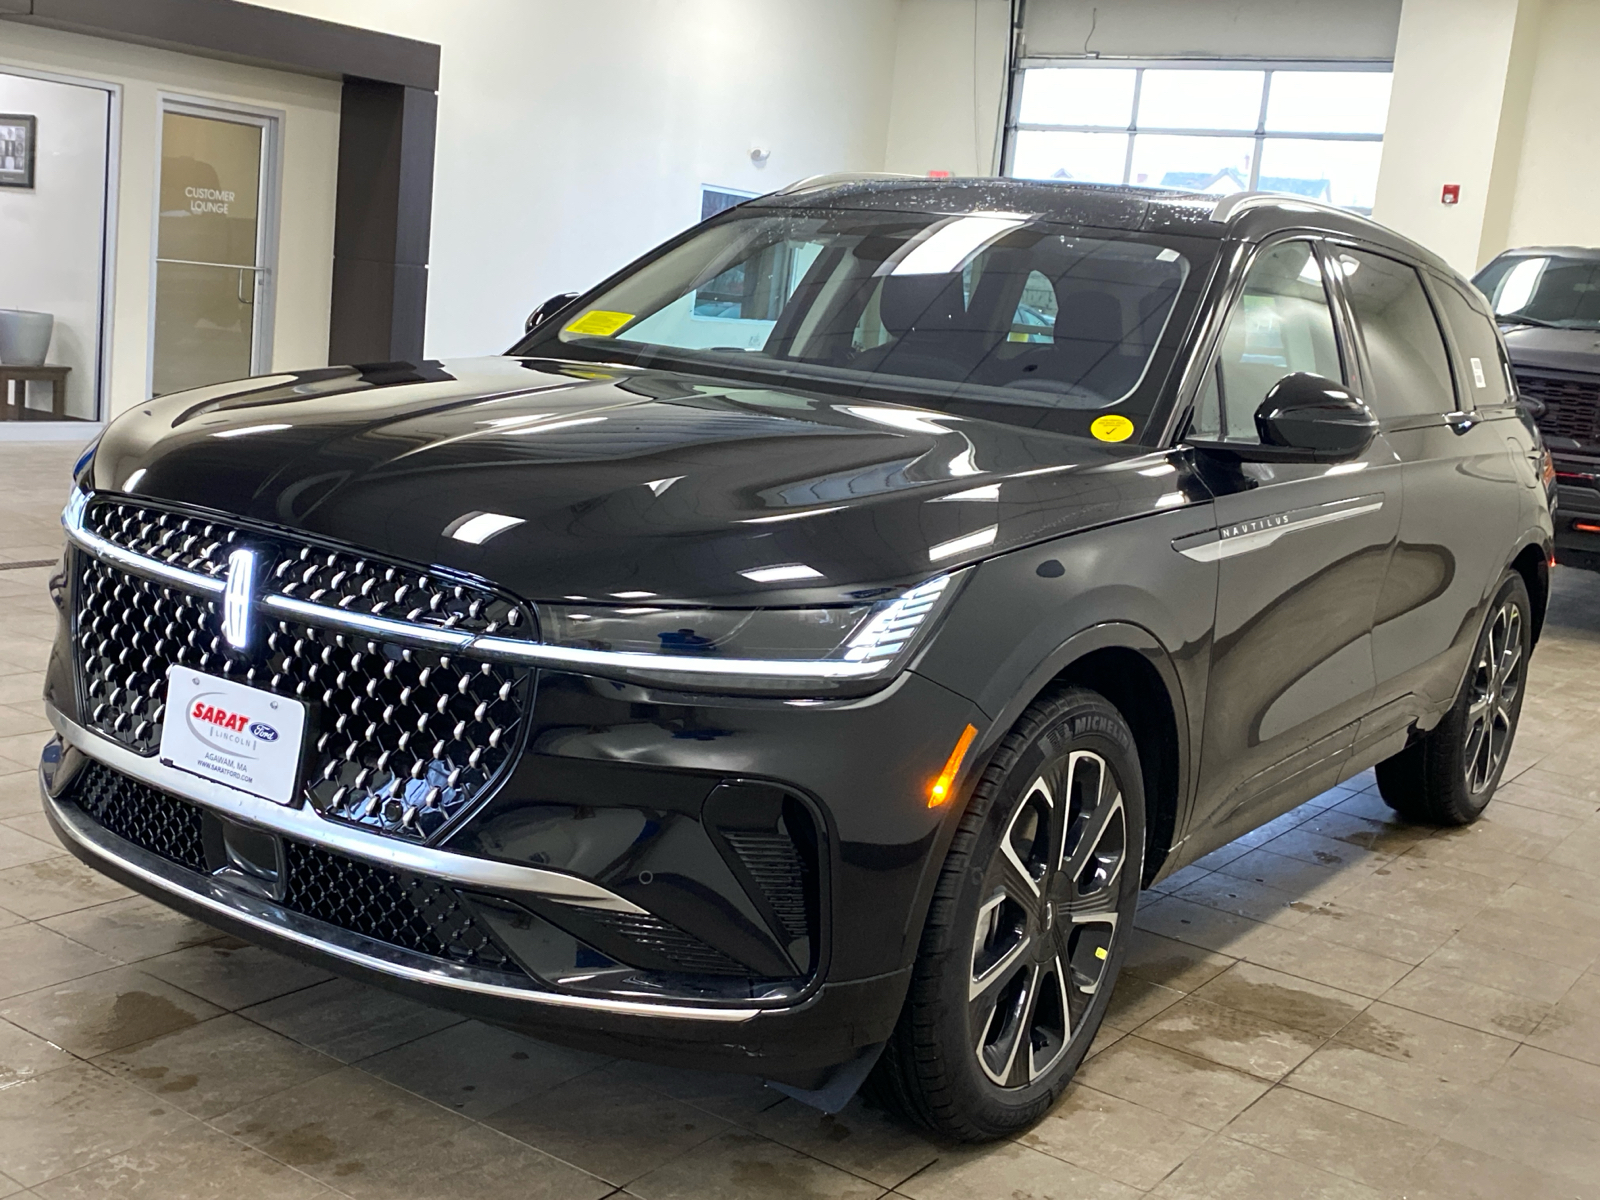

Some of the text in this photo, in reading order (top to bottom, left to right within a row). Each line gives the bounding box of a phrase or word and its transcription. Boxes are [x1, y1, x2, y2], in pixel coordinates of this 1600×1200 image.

[185, 186, 235, 202] CUSTOMER
[190, 200, 229, 215] LOUNGE
[1222, 515, 1289, 538] NAUTILUS
[192, 702, 276, 741] SARAT Ford
[215, 728, 251, 747] LINCOLN
[205, 752, 248, 773] AGAWAM, MA
